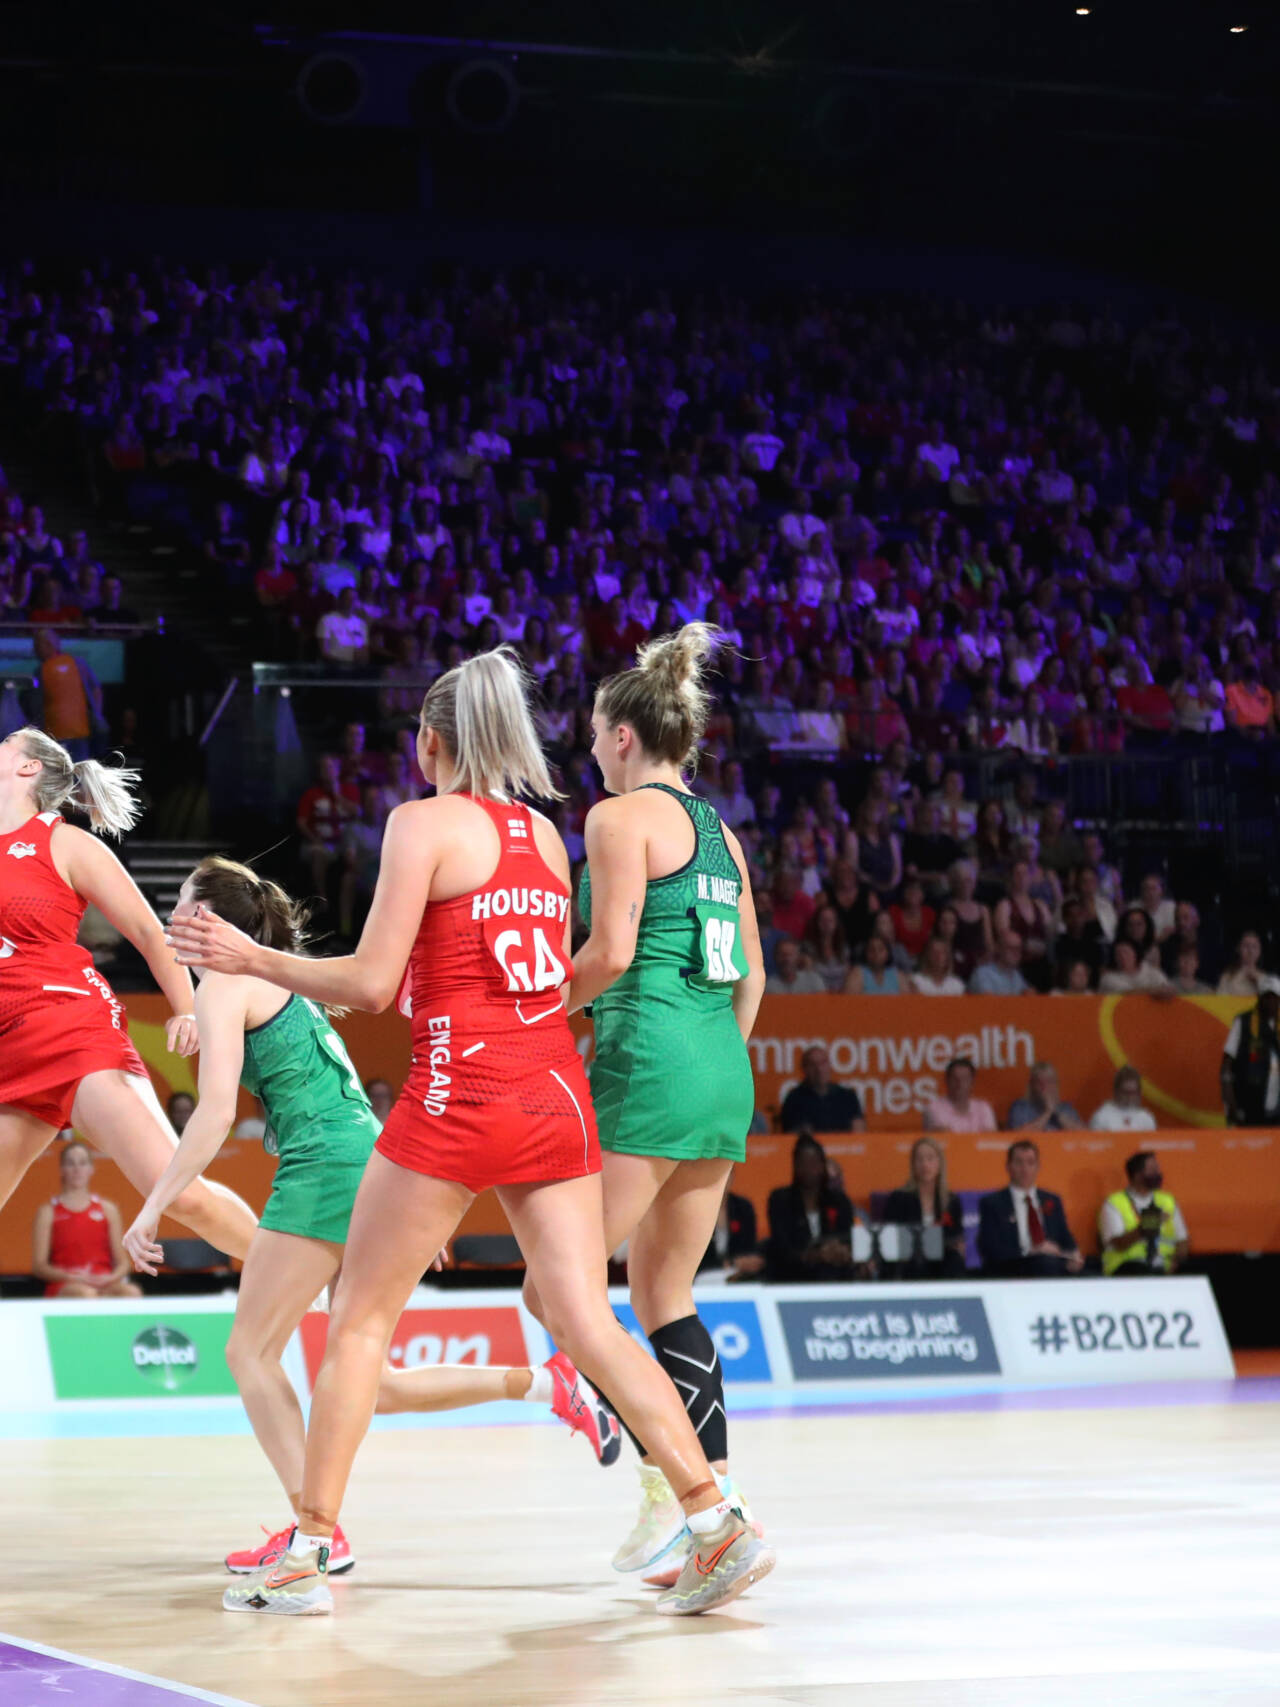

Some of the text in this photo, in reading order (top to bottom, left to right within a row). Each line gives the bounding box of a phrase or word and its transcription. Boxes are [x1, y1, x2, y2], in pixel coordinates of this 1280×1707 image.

[471, 887, 569, 923] HOUSBY
[494, 927, 565, 992] GA
[423, 1015, 452, 1117] ENGLAND
[812, 1310, 959, 1340] sport is just
[1030, 1311, 1202, 1354] #B2022
[133, 1345, 195, 1365] Dettol
[805, 1336, 979, 1364] the beginning
